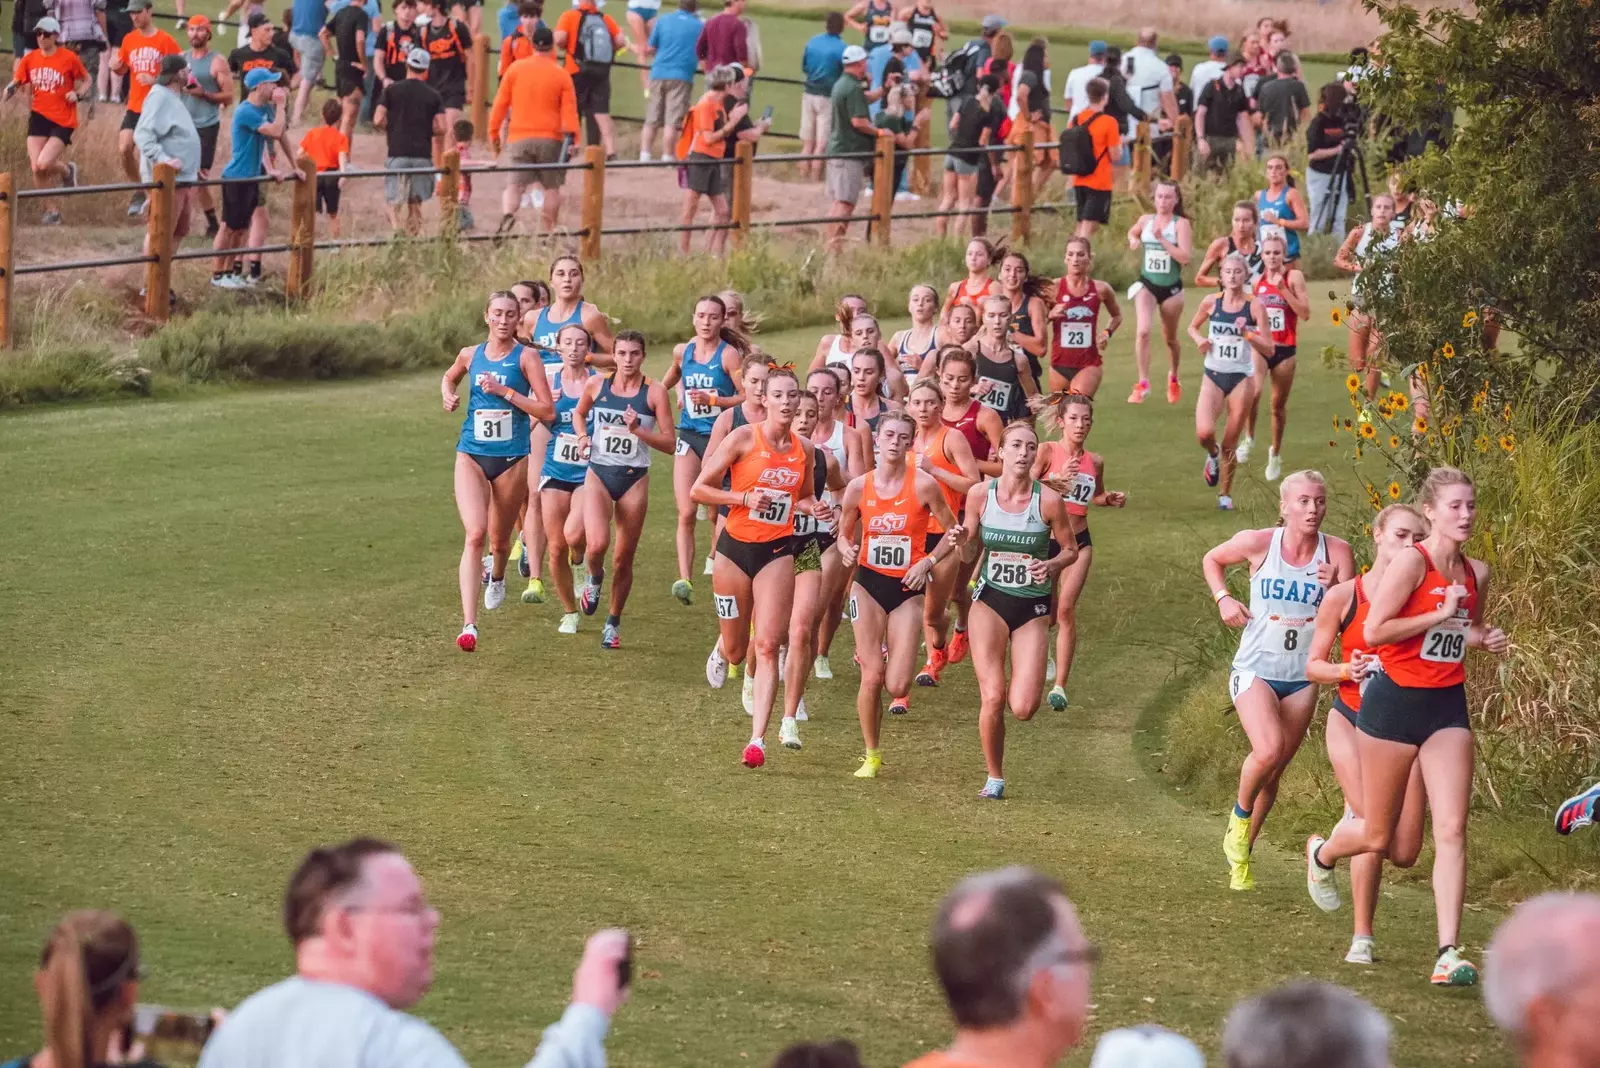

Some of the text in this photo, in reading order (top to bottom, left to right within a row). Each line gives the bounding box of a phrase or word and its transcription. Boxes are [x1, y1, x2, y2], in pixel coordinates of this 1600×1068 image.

[1148, 257, 1166, 270] 261
[1068, 331, 1084, 345] 23
[1219, 345, 1237, 359] 141
[475, 371, 507, 387] BU
[685, 373, 714, 388] BYU
[483, 420, 502, 438] 31
[604, 436, 632, 455] 129
[758, 467, 800, 488] OSU
[1061, 483, 1091, 503] 42
[868, 512, 907, 534] OSU
[984, 531, 1037, 545] UTAH VALLEY
[873, 546, 905, 567] 150
[991, 562, 1027, 585] 258
[1260, 578, 1324, 608] USAFA
[1283, 629, 1298, 651] 8
[1426, 631, 1465, 659] 209
